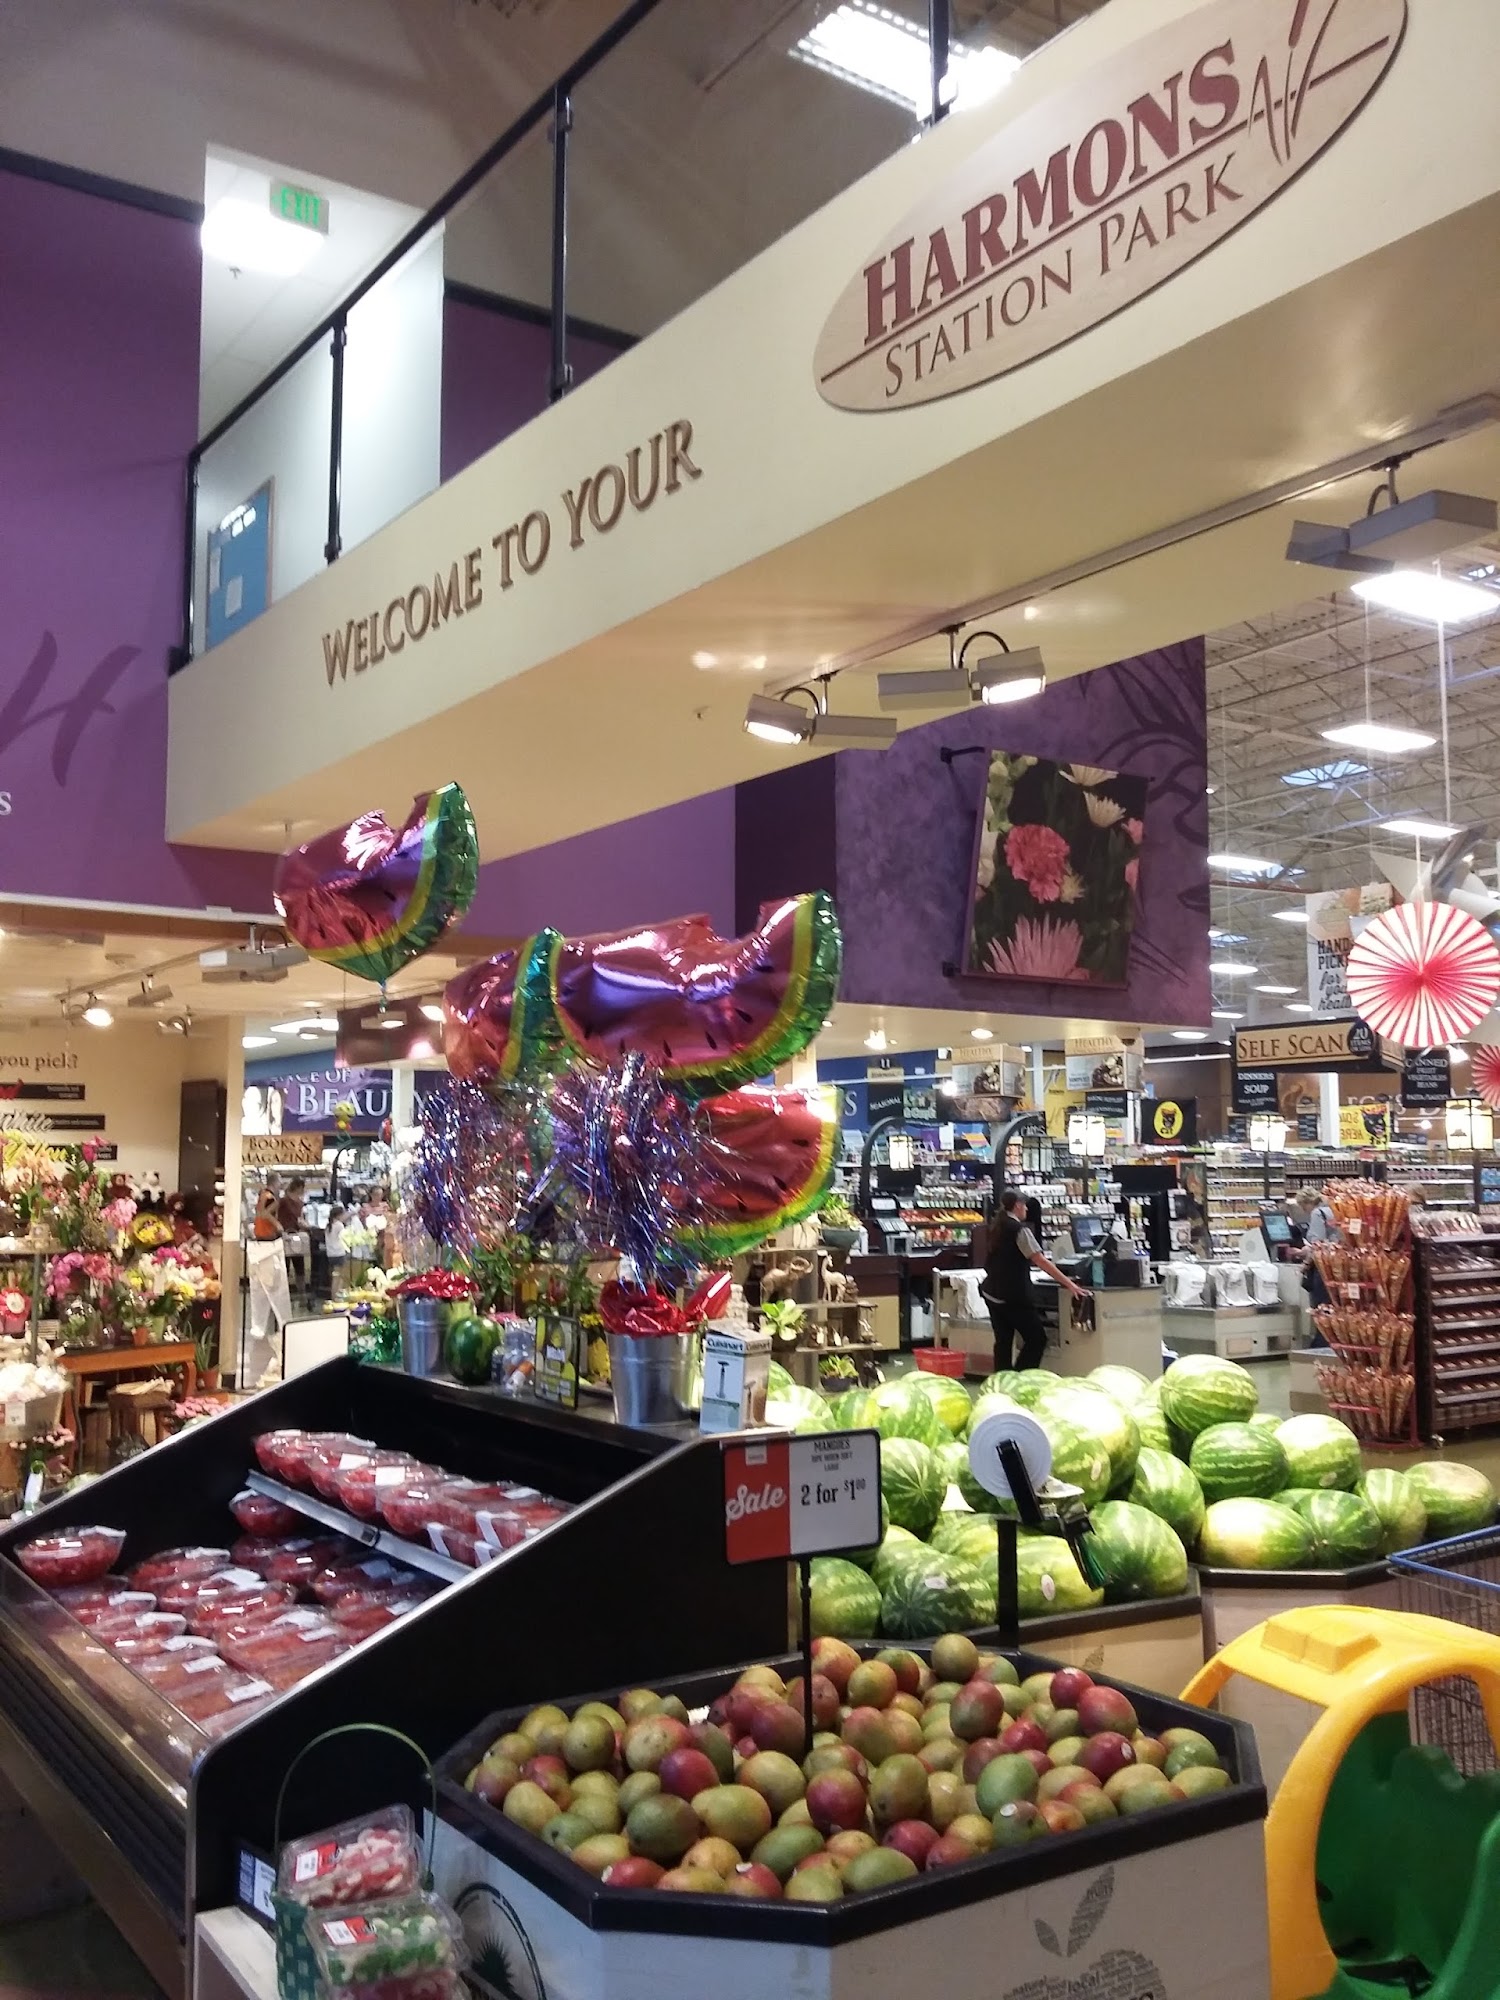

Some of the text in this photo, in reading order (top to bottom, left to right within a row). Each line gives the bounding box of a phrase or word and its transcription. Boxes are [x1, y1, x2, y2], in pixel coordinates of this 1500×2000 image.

[863, 38, 1240, 346] HARMONS
[884, 152, 1243, 398] STATION PARK
[321, 419, 702, 688] WELCOME TO YOUR
[1317, 937, 1354, 954] HAND
[1317, 954, 1349, 970] PICK
[1238, 1033, 1344, 1060] SELF SCAN
[299, 1084, 424, 1116] BEAU
[1243, 1084, 1270, 1095] SOUP
[250, 1137, 311, 1151] BOOKS &
[242, 1151, 321, 1165] MAGAZINES
[707, 1337, 743, 1351] Cuisinart
[726, 1483, 788, 1526] Sale
[800, 1484, 812, 1507] 2
[816, 1482, 839, 1505] for
